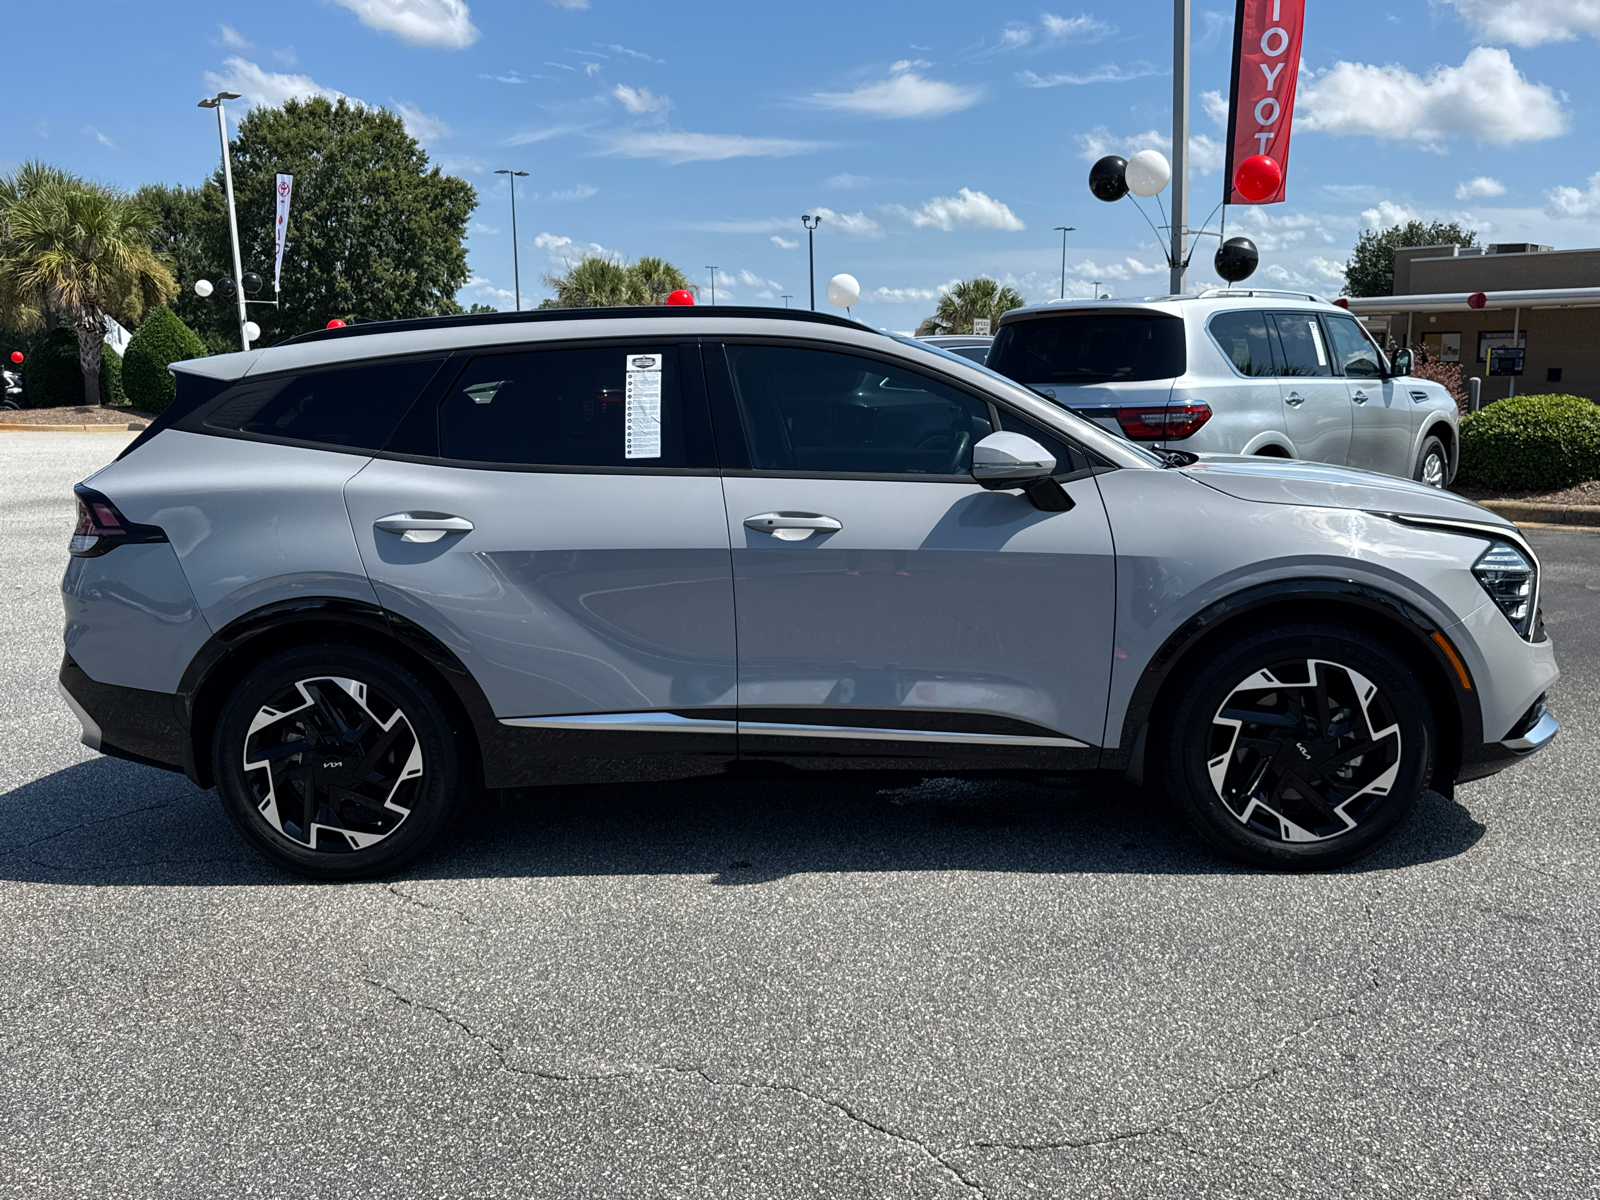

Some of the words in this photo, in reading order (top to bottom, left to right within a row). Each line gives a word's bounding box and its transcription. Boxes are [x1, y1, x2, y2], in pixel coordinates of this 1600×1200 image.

[1254, 0, 1289, 155] OYOT
[1343, 646, 1405, 691] MICHELIN
[1296, 742, 1312, 760] KIA
